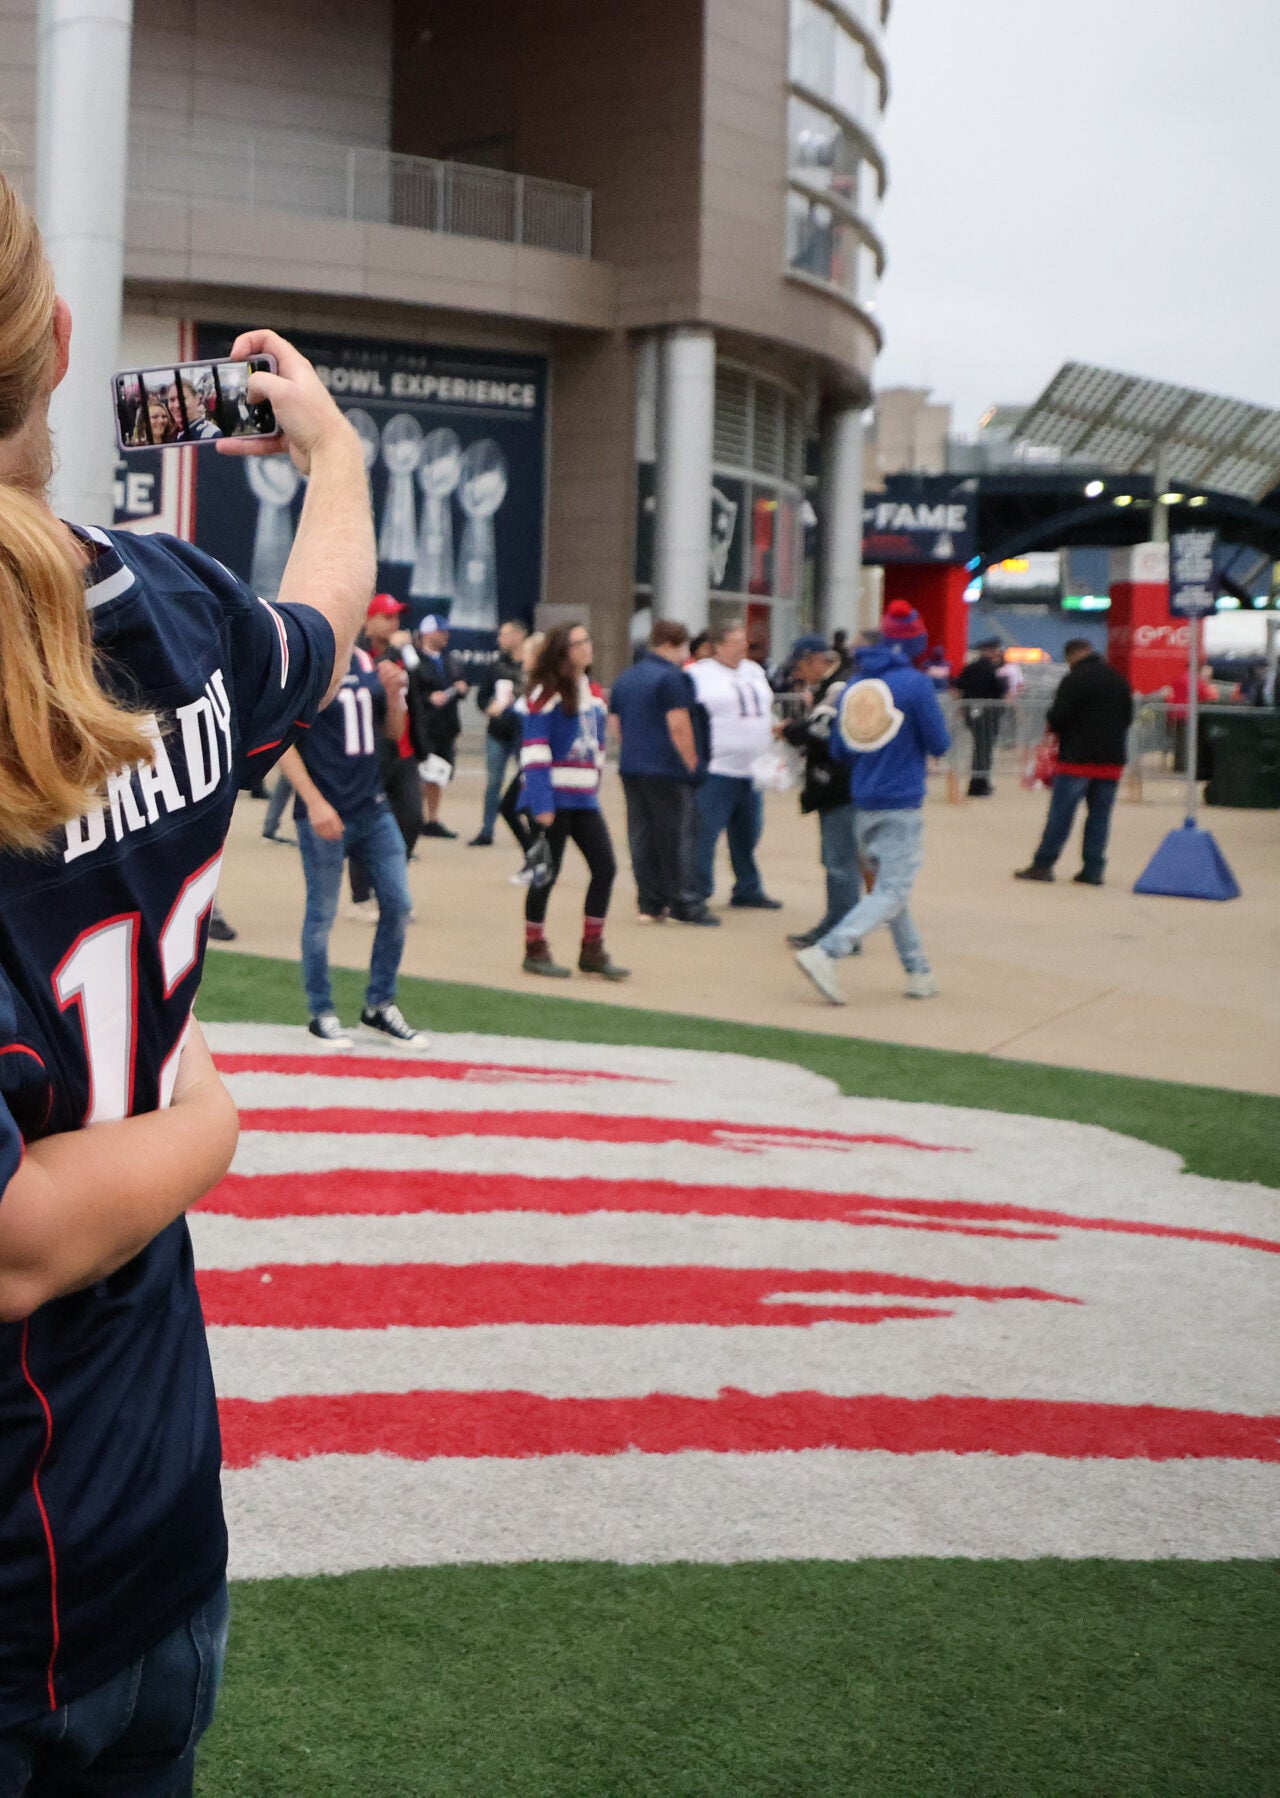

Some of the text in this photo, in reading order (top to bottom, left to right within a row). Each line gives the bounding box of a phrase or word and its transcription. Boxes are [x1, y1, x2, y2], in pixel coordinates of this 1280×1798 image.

[391, 371, 536, 408] EXPERIENCE
[874, 502, 967, 532] FAME
[337, 686, 375, 756] 11
